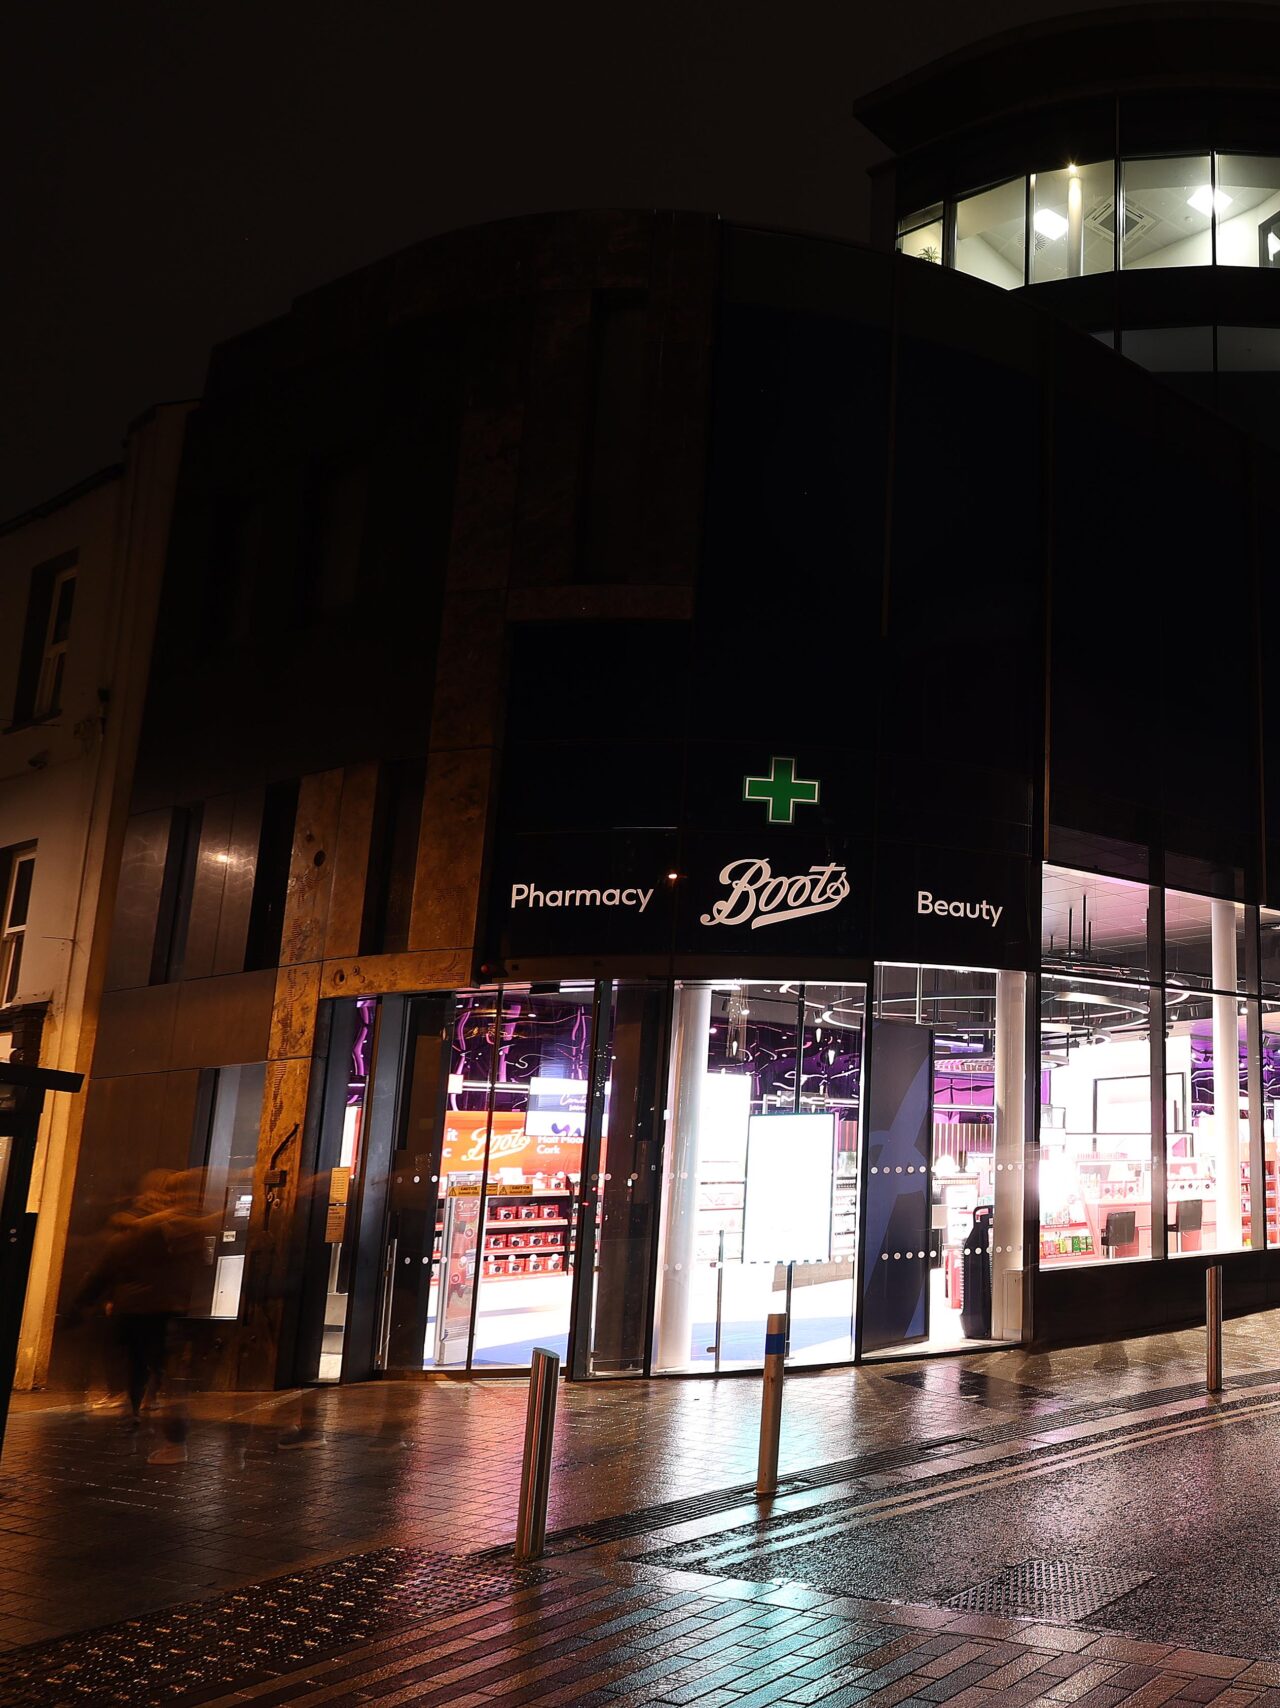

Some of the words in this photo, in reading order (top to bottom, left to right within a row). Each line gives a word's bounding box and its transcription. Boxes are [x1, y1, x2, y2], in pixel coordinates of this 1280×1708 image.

[510, 883, 654, 912] Pharmacy
[700, 858, 850, 930] Boots
[917, 891, 1003, 926] Beauty
[460, 1127, 531, 1162] Boots
[537, 1145, 560, 1155] Cork
